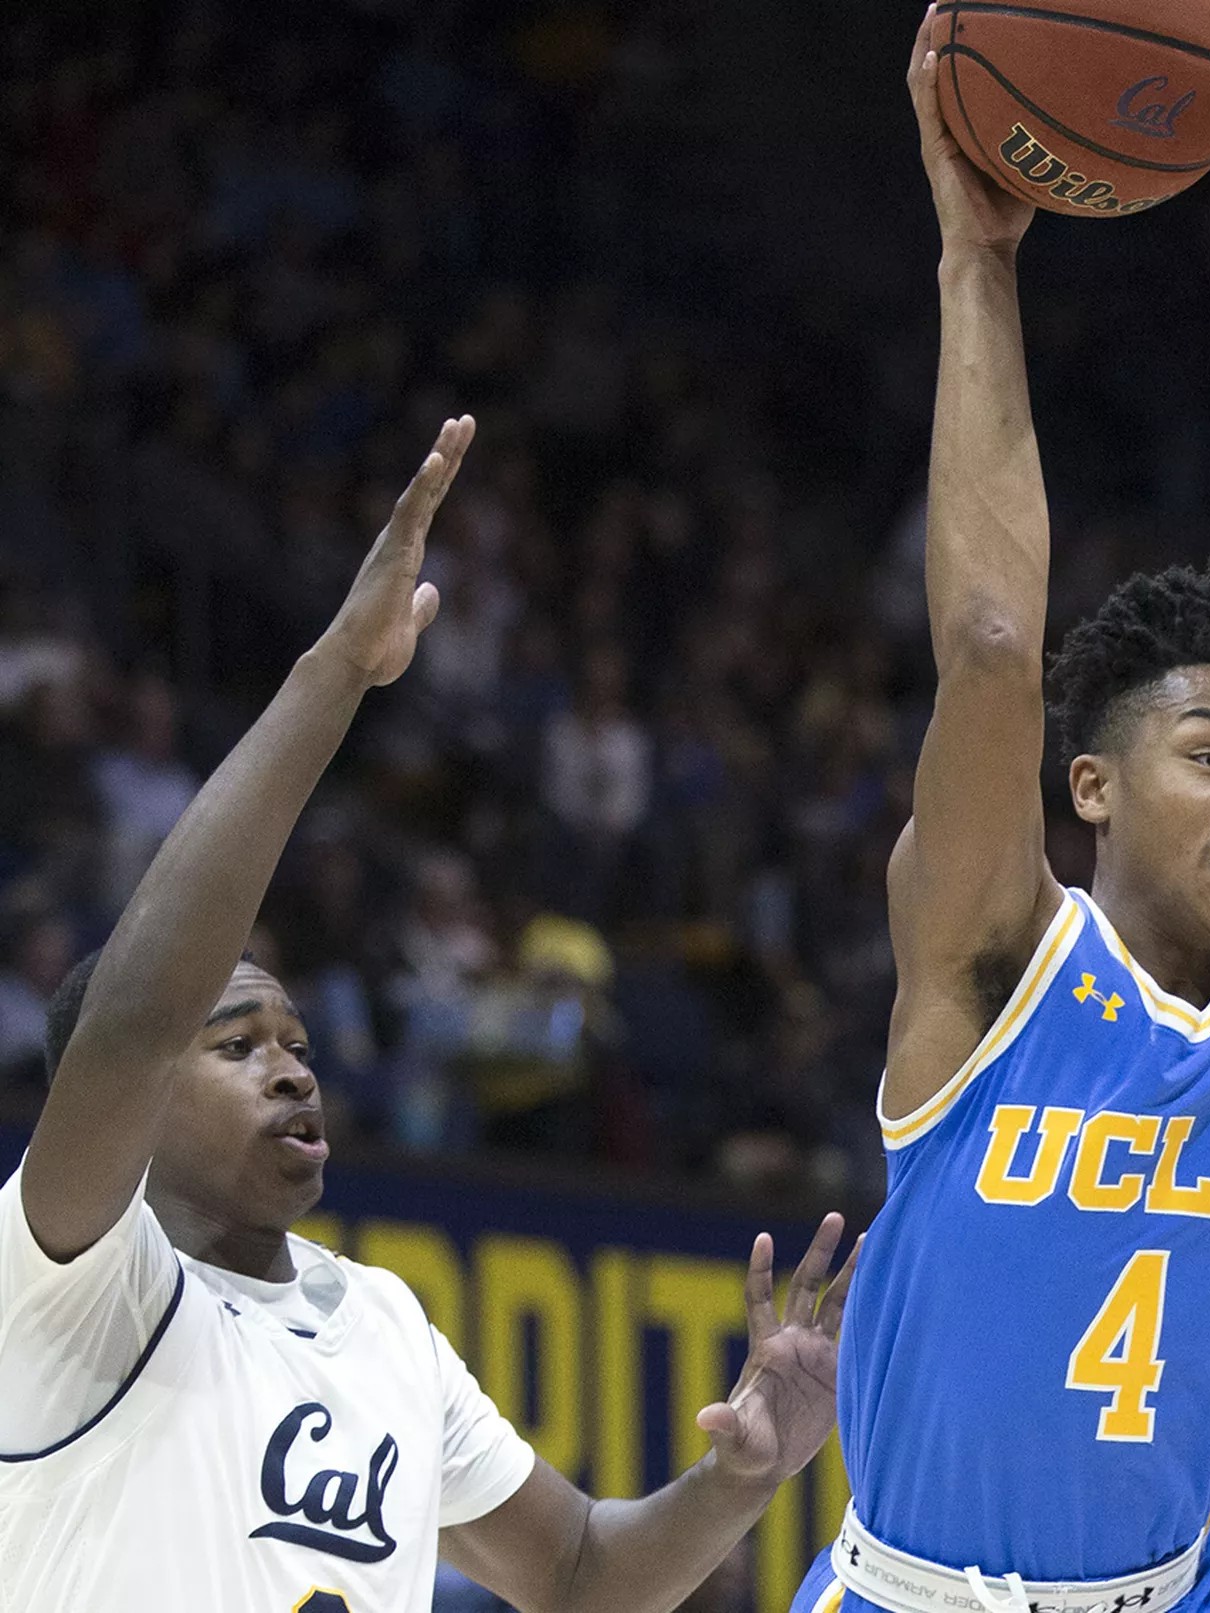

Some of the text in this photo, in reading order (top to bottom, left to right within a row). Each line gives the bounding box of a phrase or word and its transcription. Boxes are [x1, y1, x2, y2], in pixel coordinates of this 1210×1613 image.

[998, 121, 1172, 213] Wilso
[1107, 75, 1197, 138] Cal
[1065, 1250, 1171, 1442] 4
[248, 1402, 399, 1564] Cal
